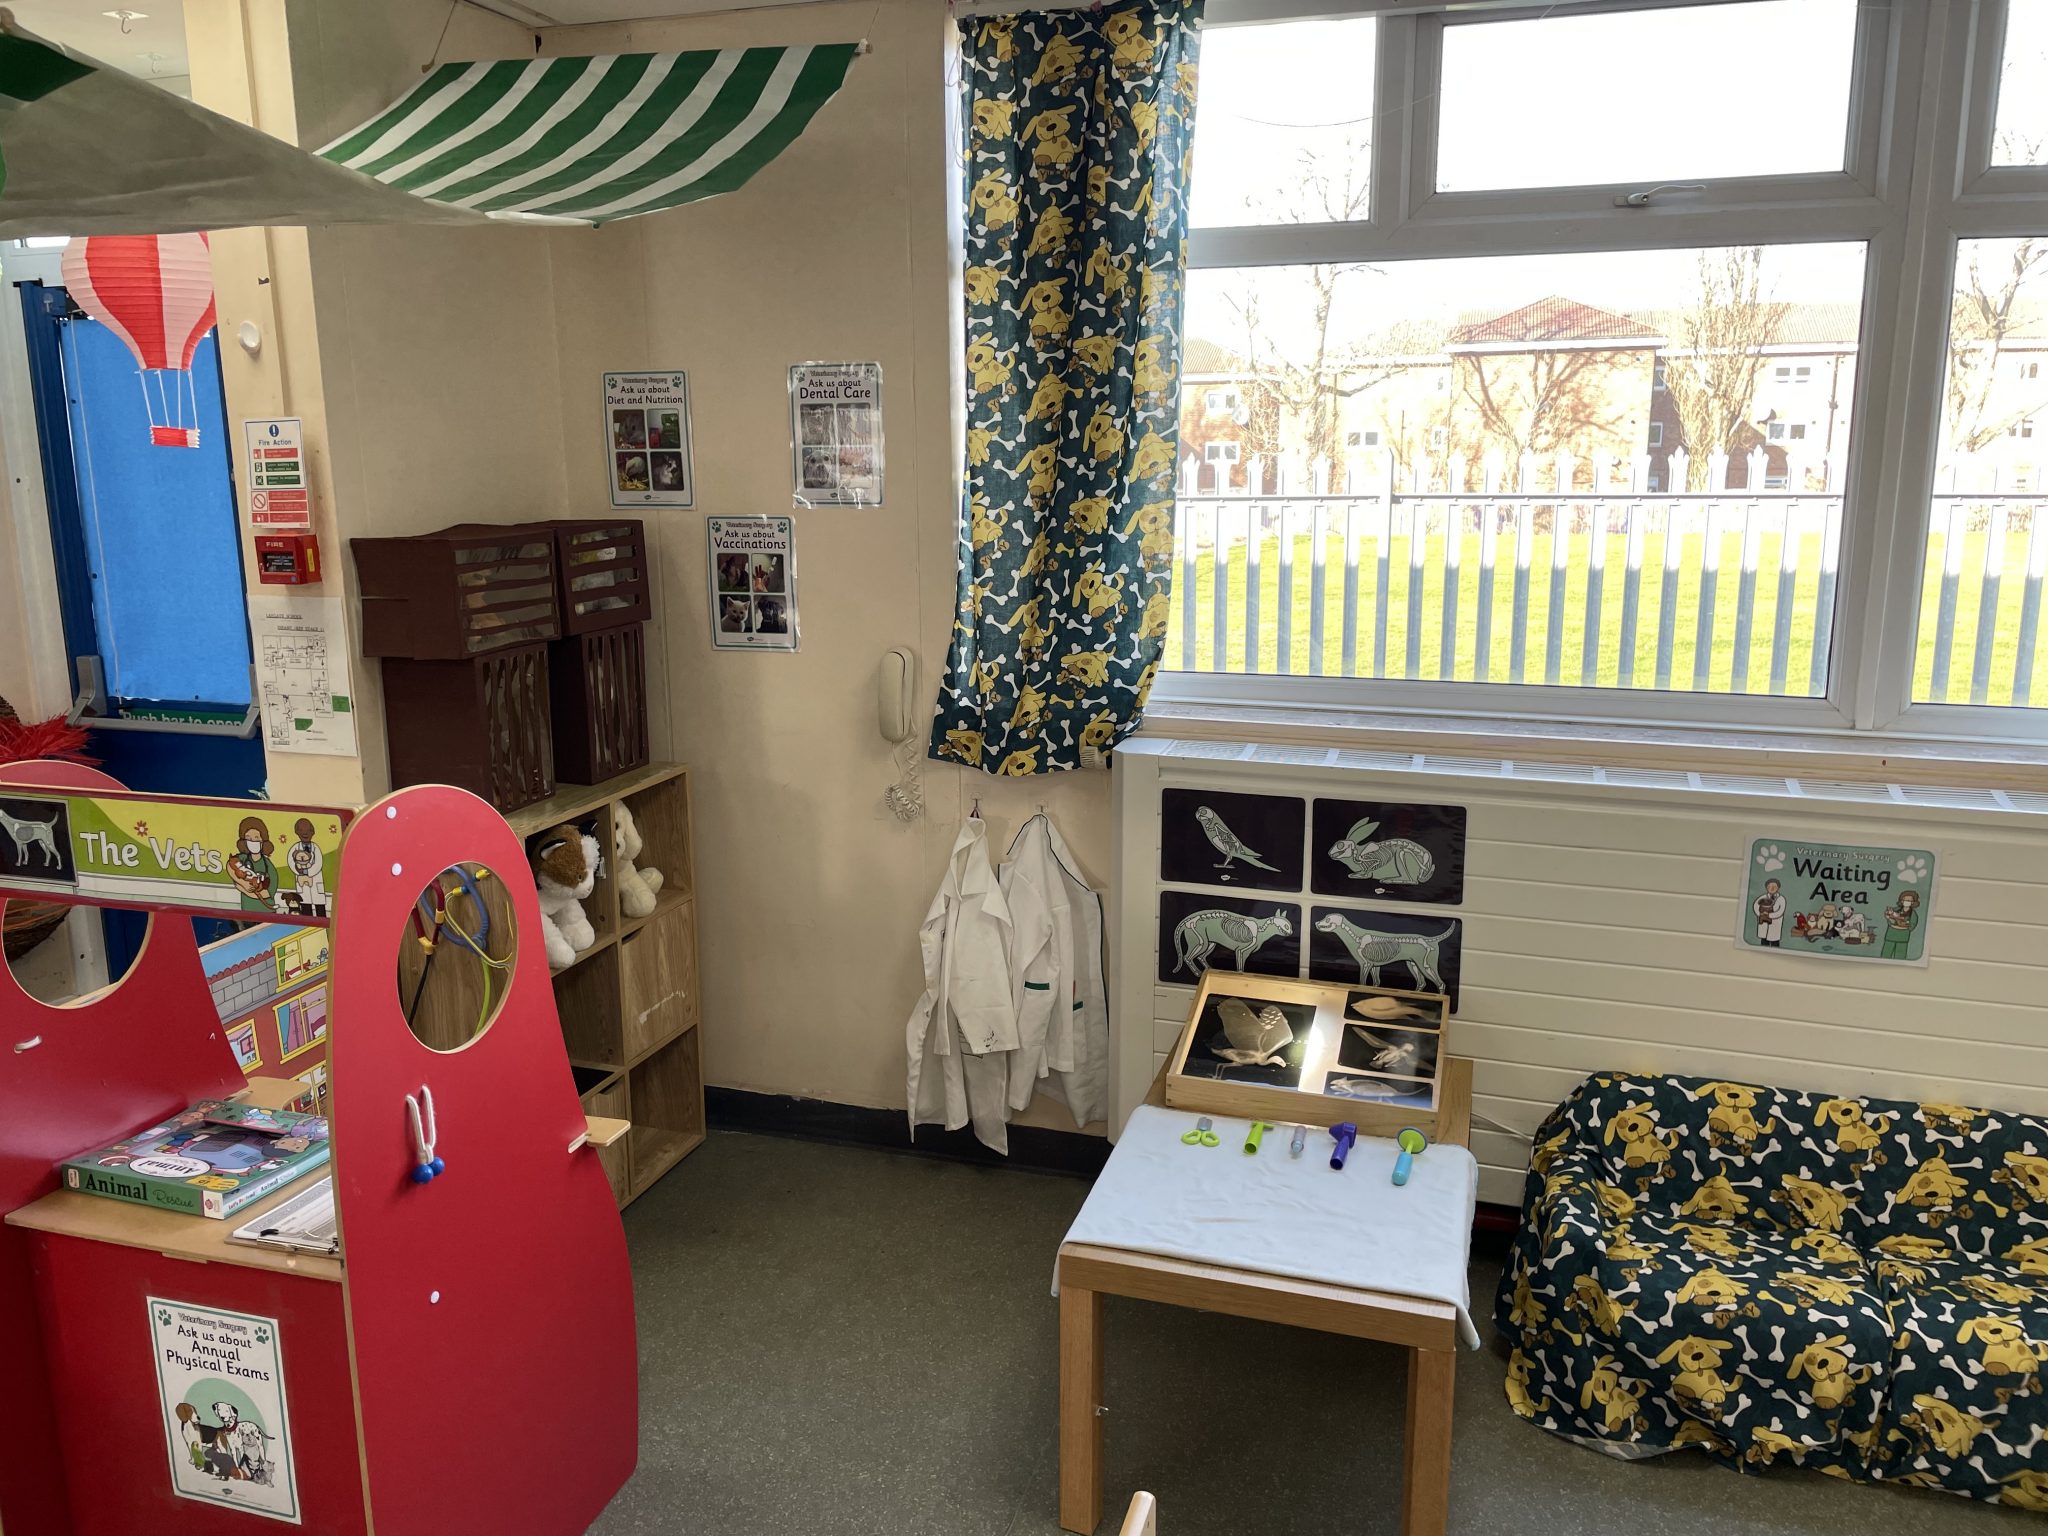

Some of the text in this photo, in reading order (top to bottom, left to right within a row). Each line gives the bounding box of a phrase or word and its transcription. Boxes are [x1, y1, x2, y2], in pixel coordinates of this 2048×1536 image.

[620, 386, 635, 394] Ask
[800, 386, 871, 399] Dental Care
[808, 379, 824, 387] Ask
[837, 379, 862, 387] about
[607, 395, 683, 405] Diet and Nutrition
[714, 537, 786, 549] Vaccinations
[724, 530, 739, 538] Ask
[752, 530, 775, 538] about
[79, 831, 224, 874] The Vets
[1796, 847, 1891, 863] Veterinary Surgery
[1793, 857, 1892, 891] Waiting
[1809, 882, 1869, 905] Area
[85, 1173, 195, 1209] Animal Rescue
[178, 1312, 248, 1336] Veterinary Surgery
[177, 1325, 252, 1349] Ask us about
[191, 1340, 241, 1362] Annual
[166, 1350, 270, 1382] Physical Exams
